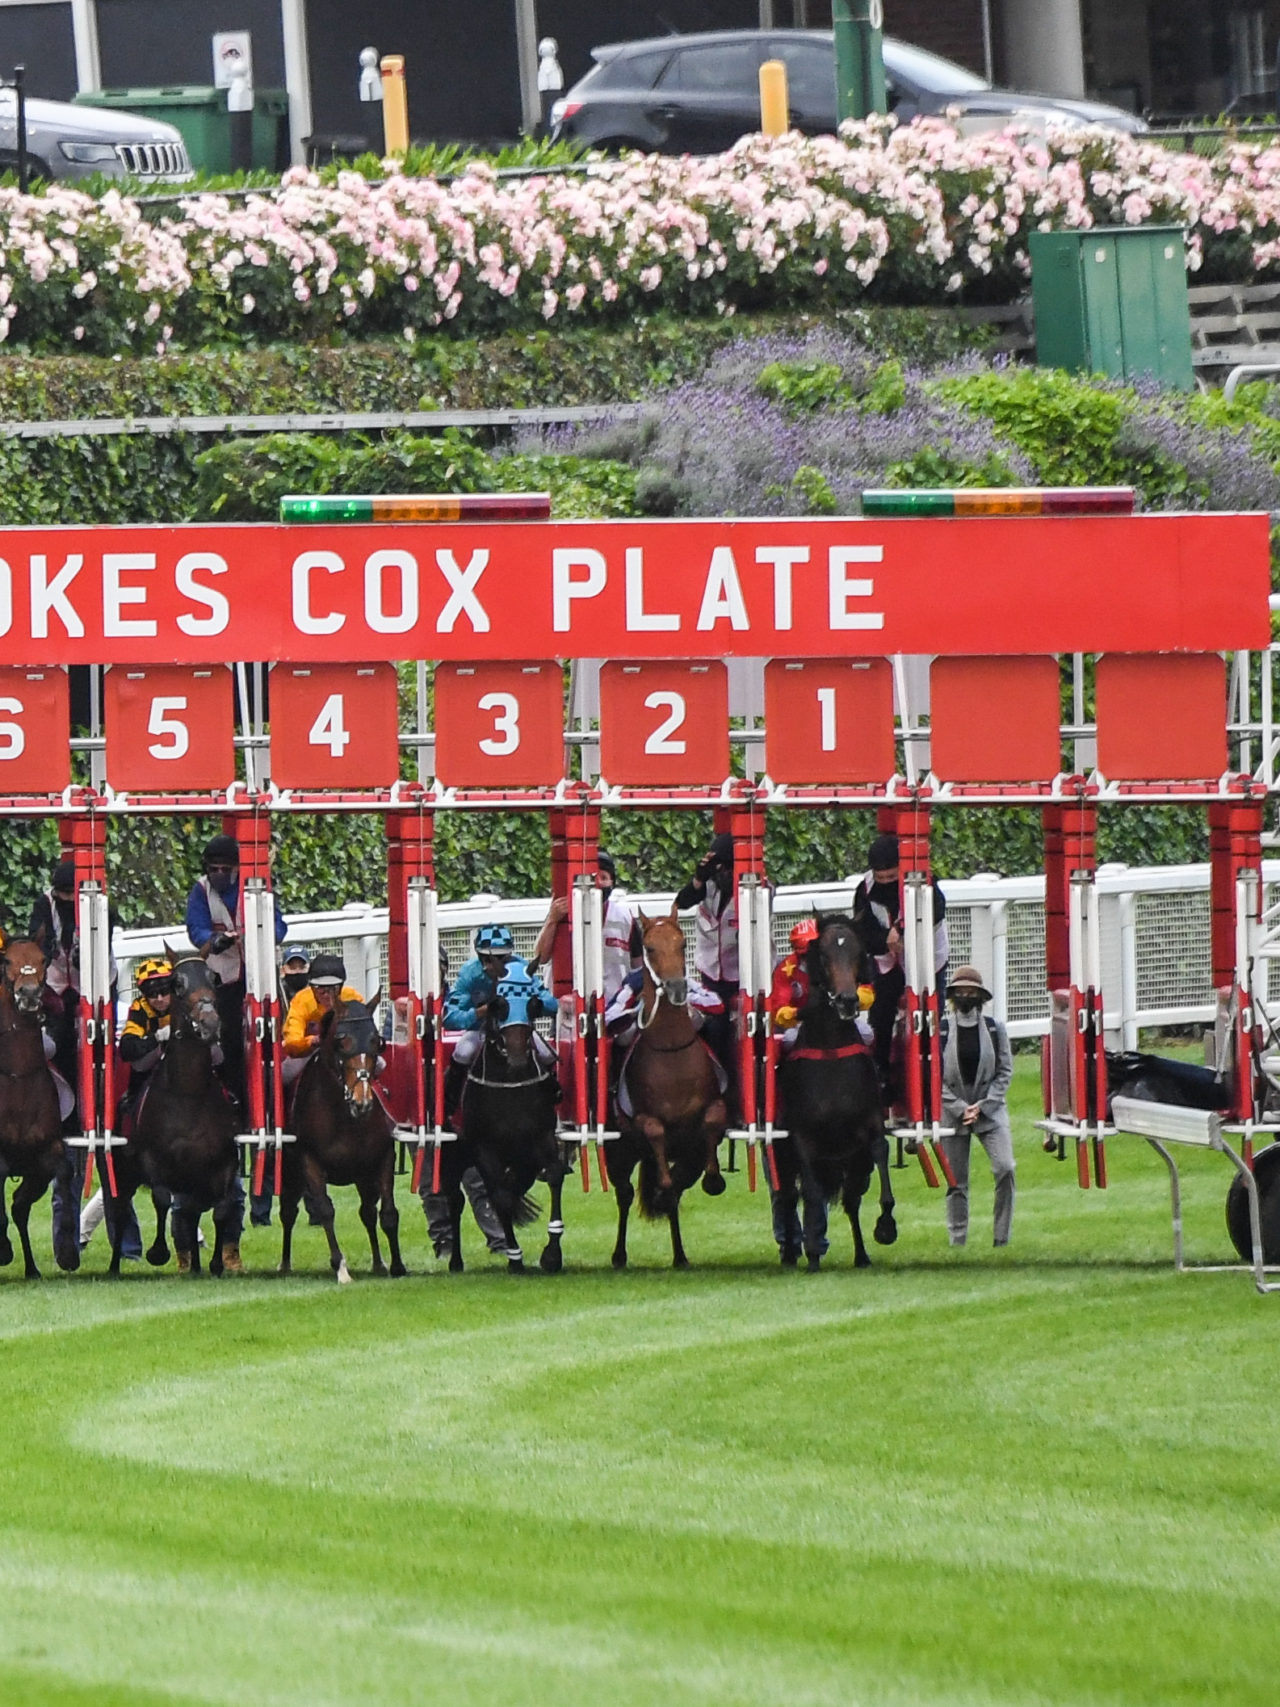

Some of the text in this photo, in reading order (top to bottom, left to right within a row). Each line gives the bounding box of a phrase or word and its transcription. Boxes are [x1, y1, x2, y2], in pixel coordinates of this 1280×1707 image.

[290, 547, 492, 636] COX
[551, 543, 886, 634] PLATE
[146, 695, 190, 761] 5
[307, 692, 351, 759] 4
[477, 691, 520, 757] 3
[644, 689, 688, 755] 2
[816, 686, 838, 752] 1
